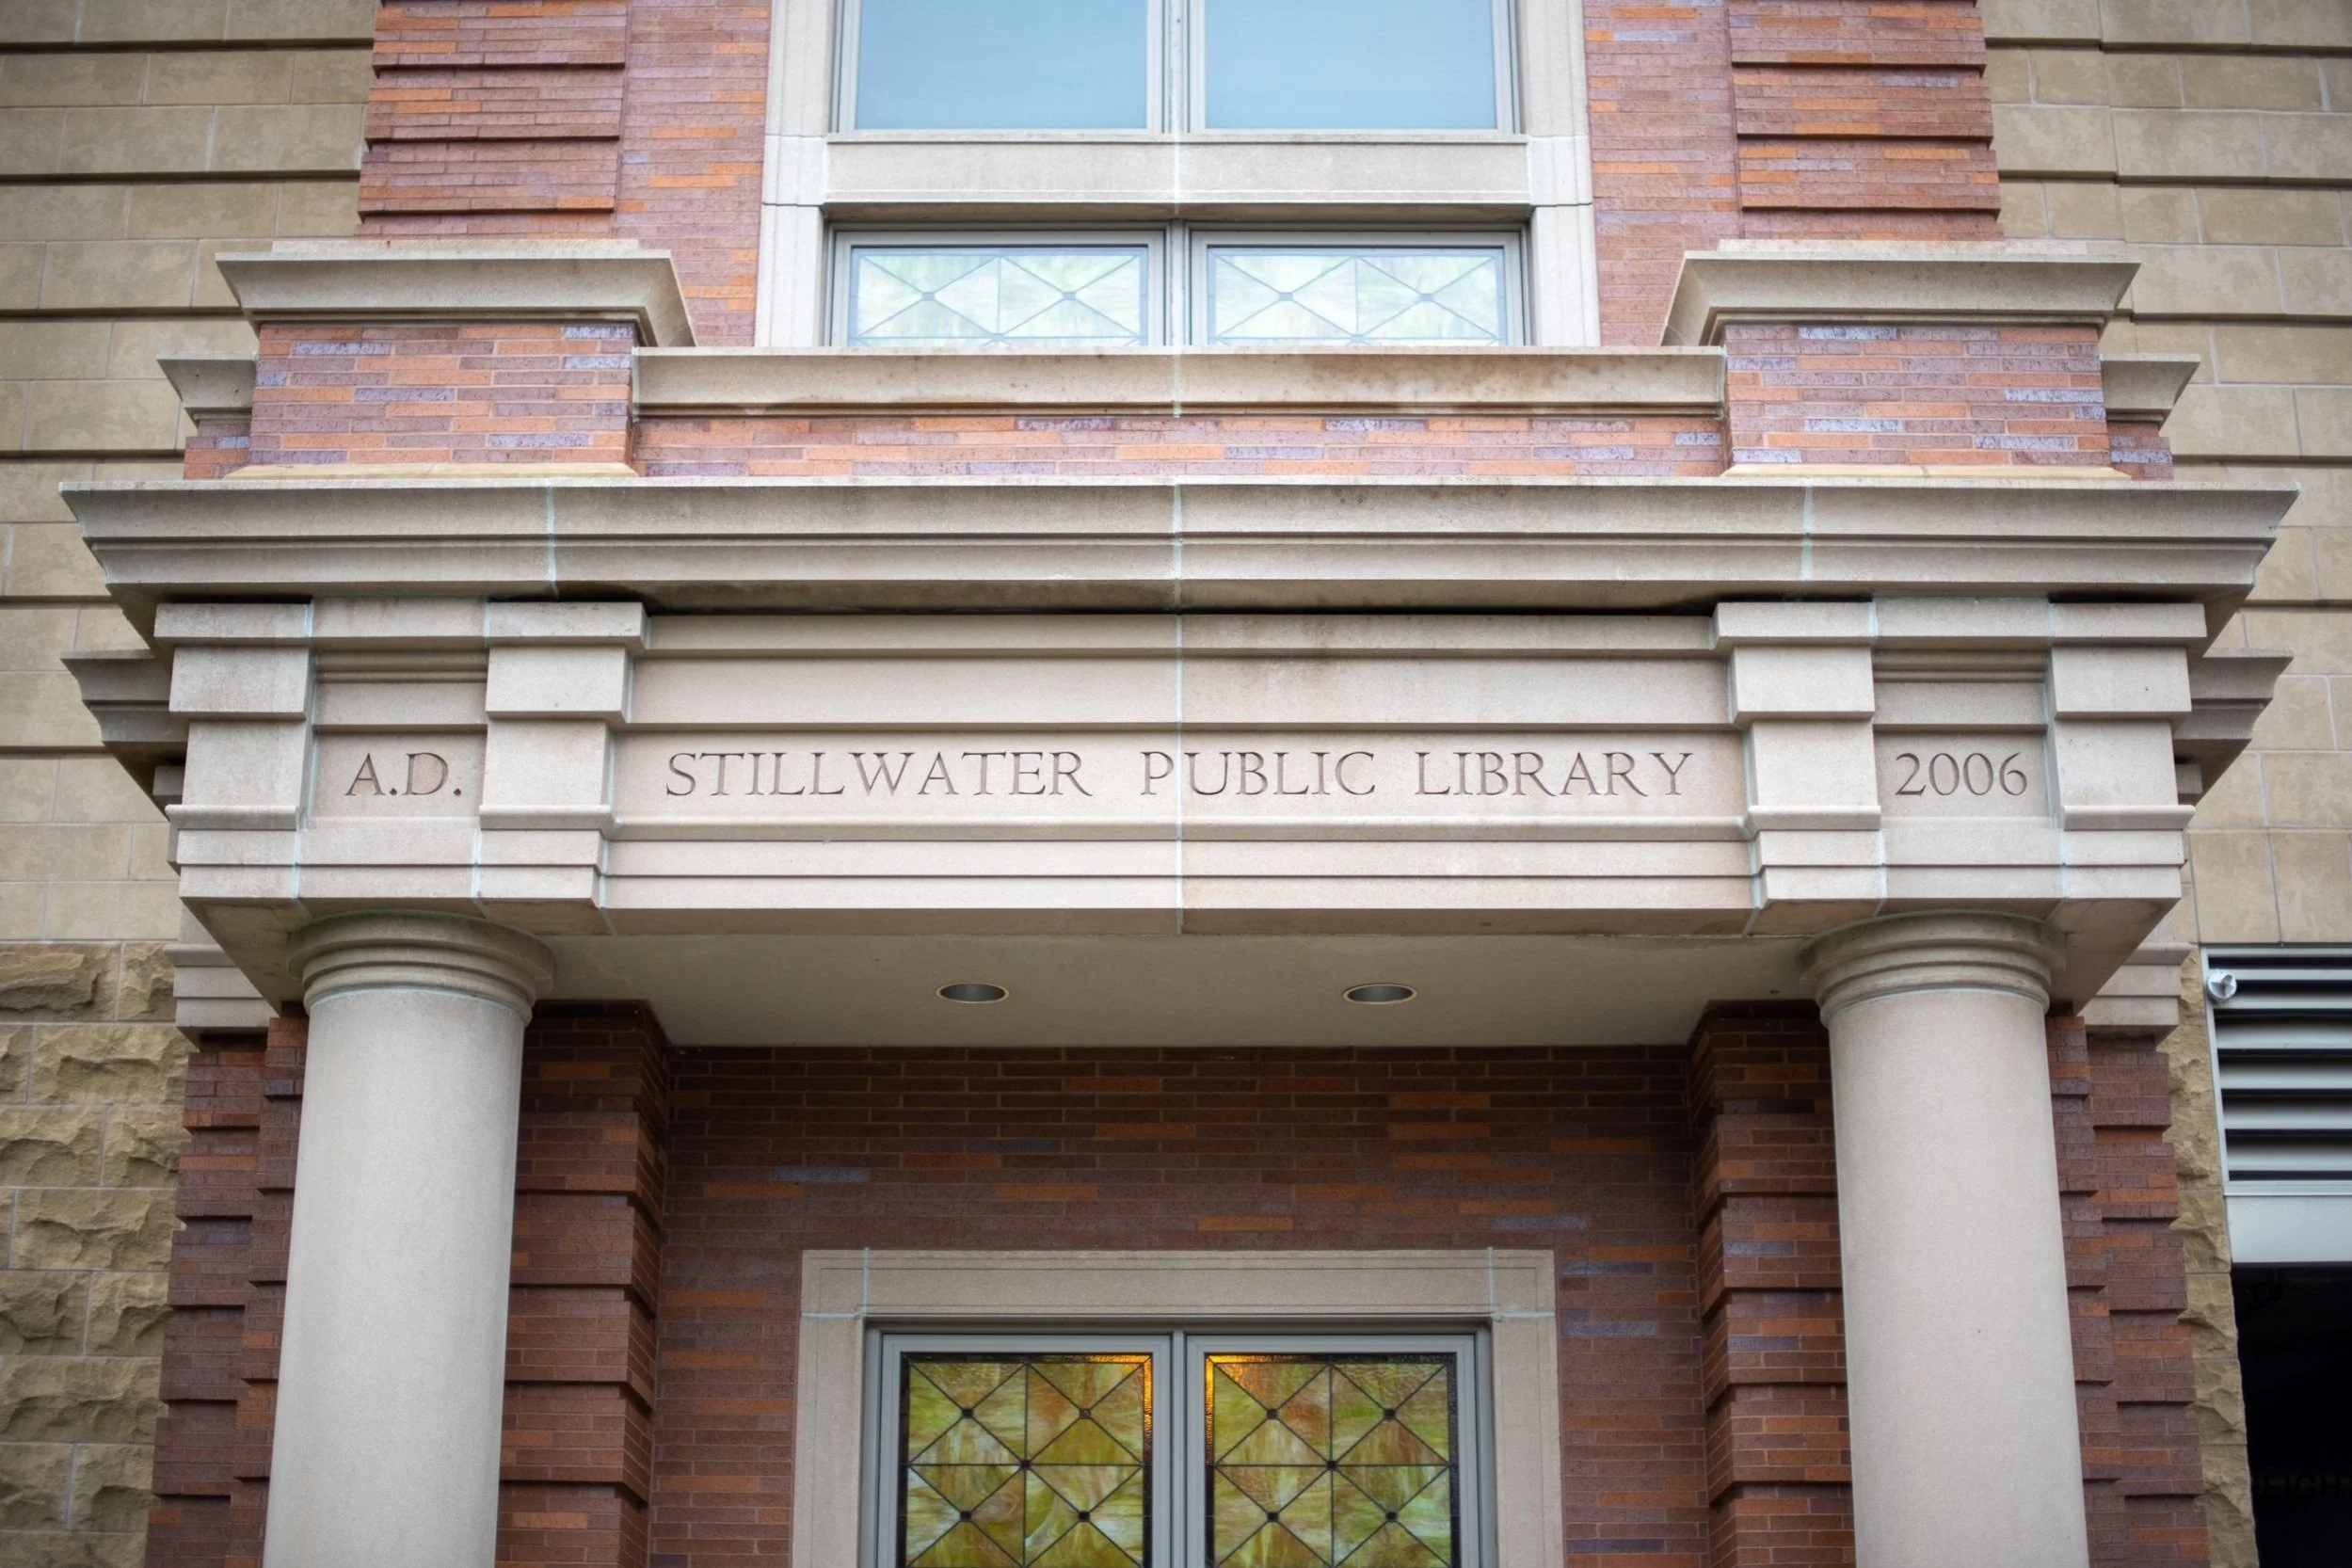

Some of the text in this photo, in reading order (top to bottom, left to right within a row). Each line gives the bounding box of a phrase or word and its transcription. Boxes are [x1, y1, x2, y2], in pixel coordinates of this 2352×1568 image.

[344, 752, 461, 796] A.D.
[666, 751, 1694, 797] STILLWATER PUBLIC LIBRARY
[1895, 752, 2028, 796] 2006
